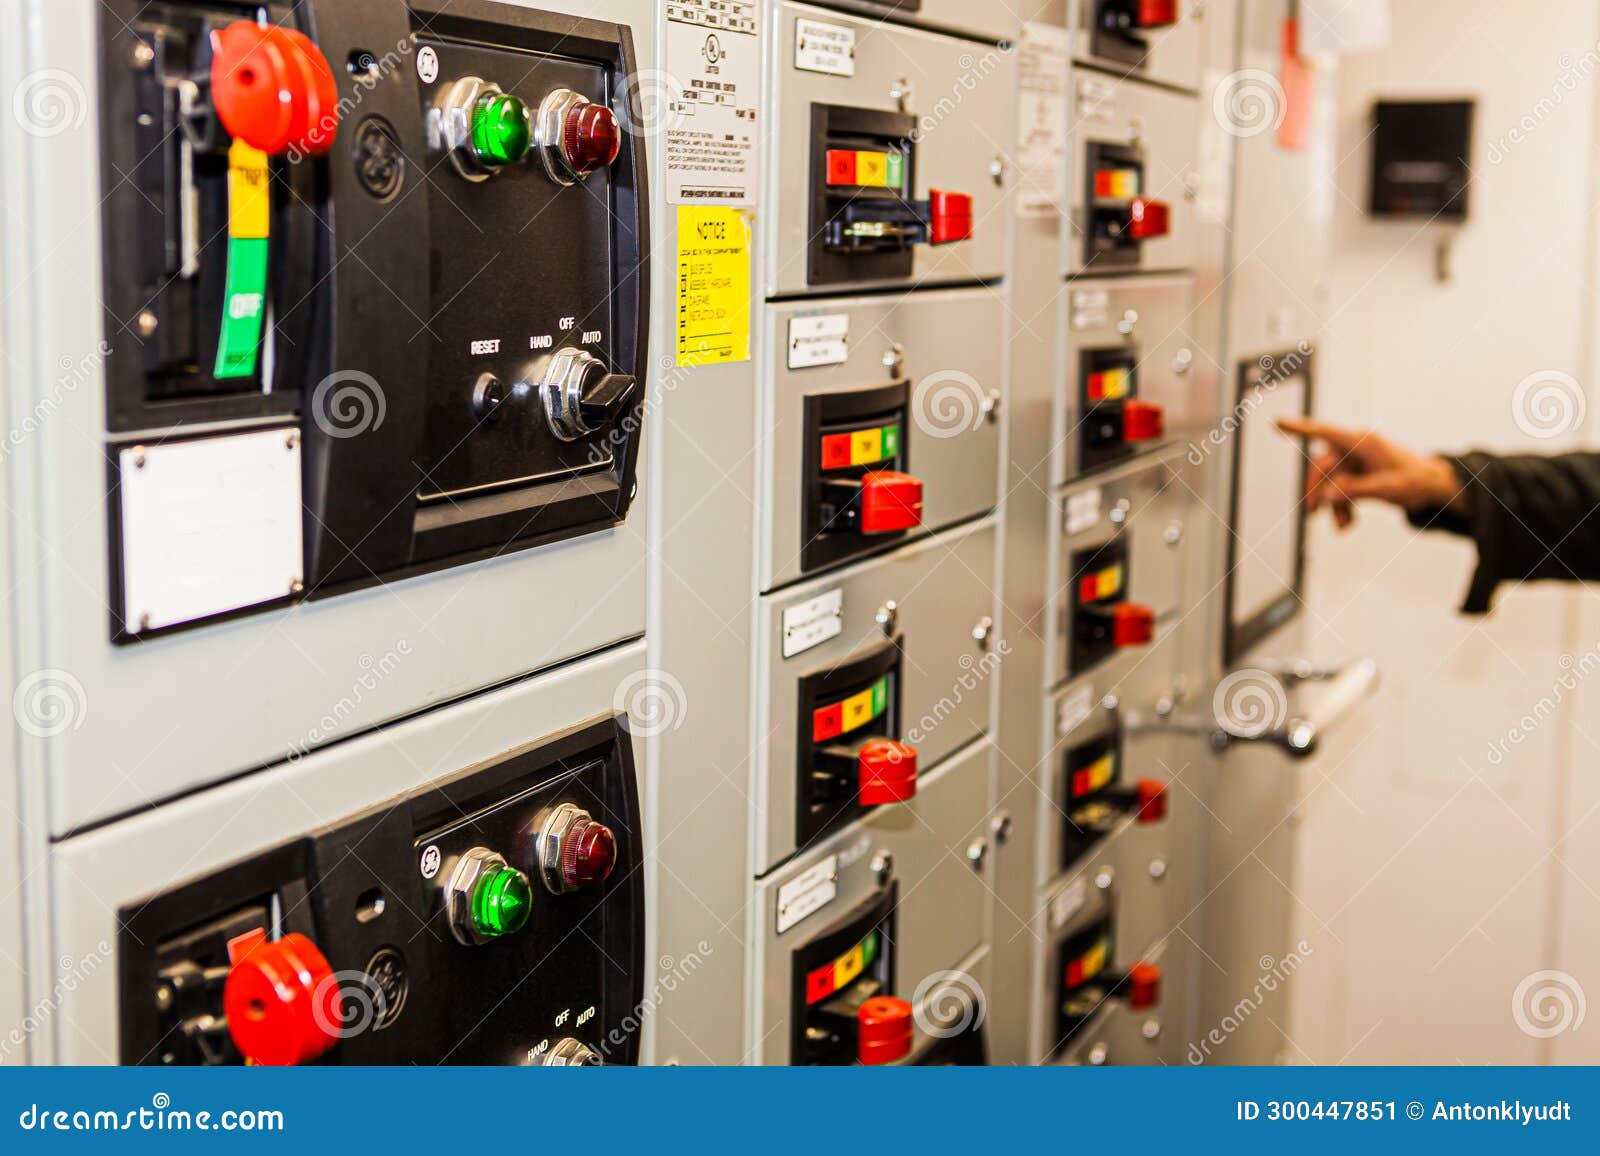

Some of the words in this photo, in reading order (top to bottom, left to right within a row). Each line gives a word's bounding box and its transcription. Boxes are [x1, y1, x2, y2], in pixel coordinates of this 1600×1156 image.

[697, 221, 726, 240] NOTICE
[559, 316, 576, 331] OFF
[470, 338, 501, 355] RESET
[529, 334, 553, 350] HAND
[581, 330, 602, 345] AUTO
[555, 1008, 571, 1027] OFF
[575, 1005, 596, 1028] AUTO
[527, 1038, 549, 1061] HAND
